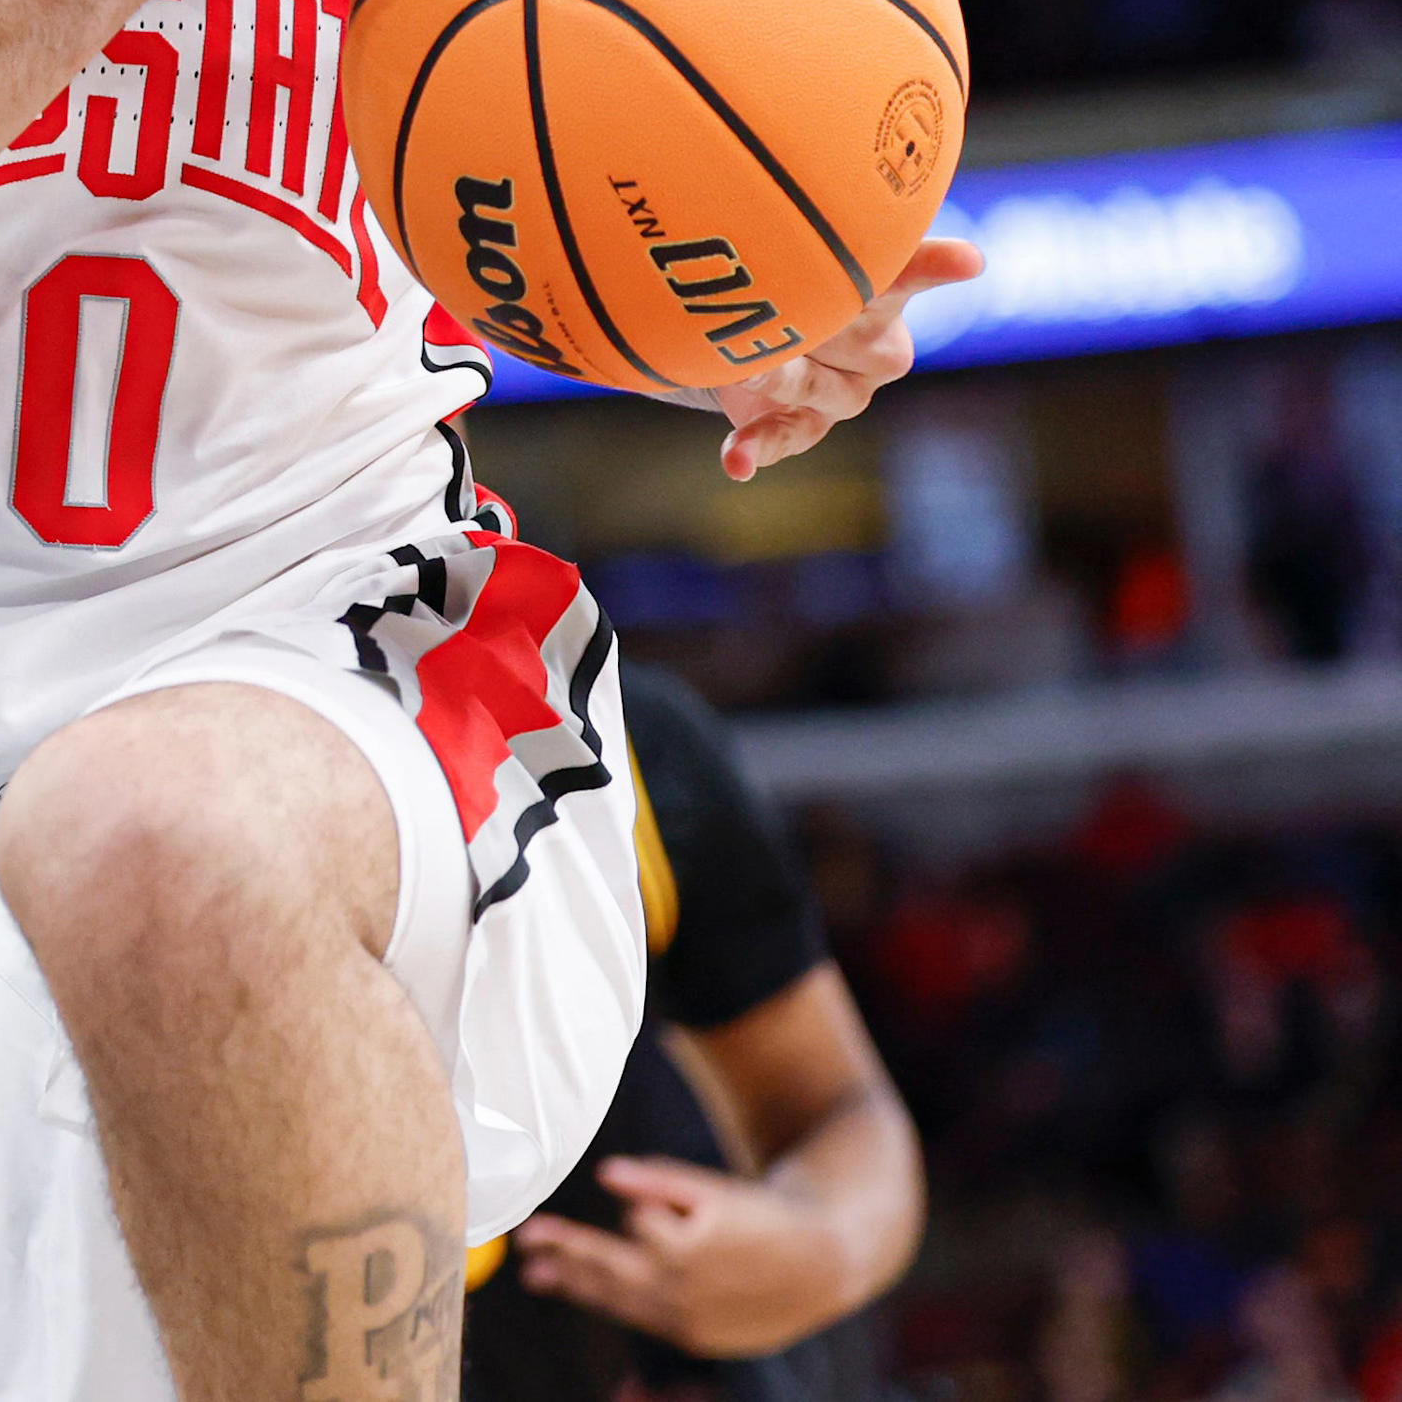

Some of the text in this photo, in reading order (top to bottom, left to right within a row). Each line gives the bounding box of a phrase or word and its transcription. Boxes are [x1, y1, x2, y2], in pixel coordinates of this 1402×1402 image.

[608, 174, 806, 366] EVO NXT
[7, 251, 182, 550] 0
